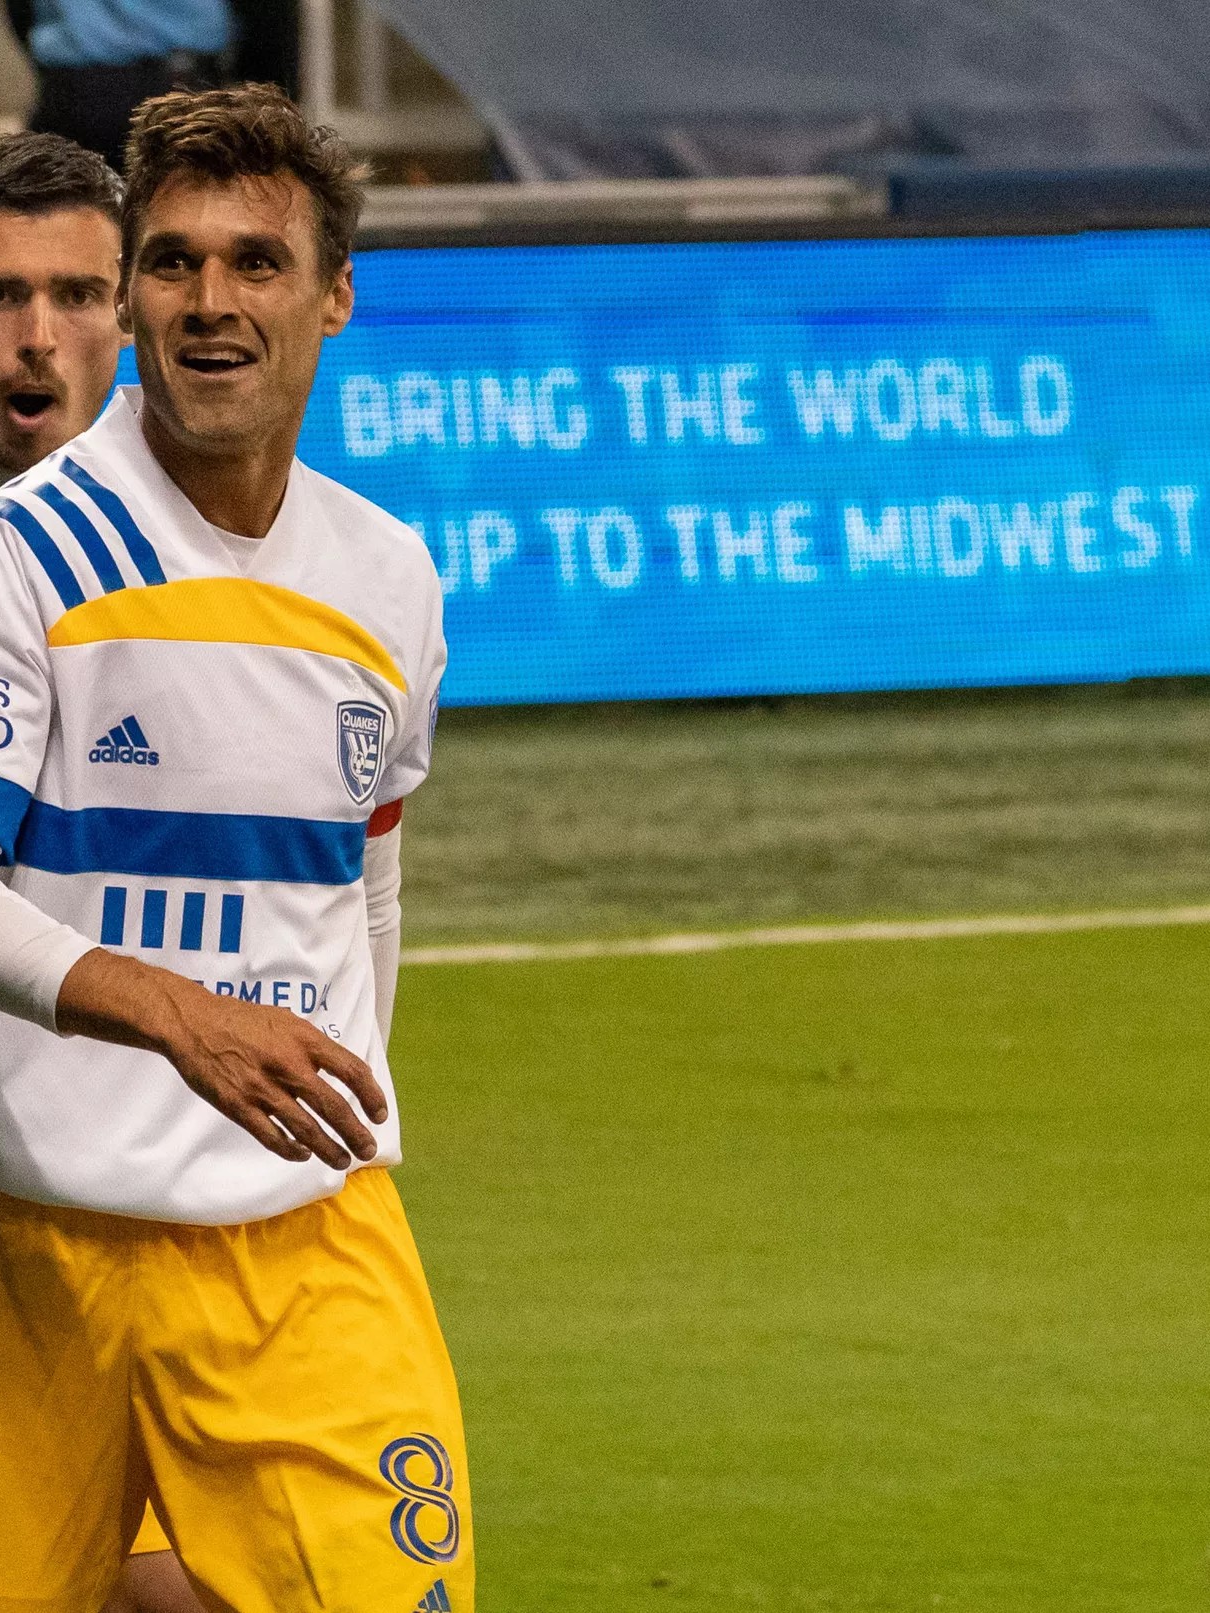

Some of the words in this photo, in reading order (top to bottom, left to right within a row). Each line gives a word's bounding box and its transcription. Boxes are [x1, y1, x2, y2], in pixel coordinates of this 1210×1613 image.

[340, 367, 588, 457] BRING
[613, 362, 764, 445] THE
[788, 356, 1073, 440] WORLD
[542, 507, 643, 588] TO
[666, 503, 818, 584] THE
[843, 484, 1199, 577] MIDWEST
[89, 745, 160, 766] adidas
[342, 711, 379, 731] QUAKES
[379, 1432, 460, 1566] 8
